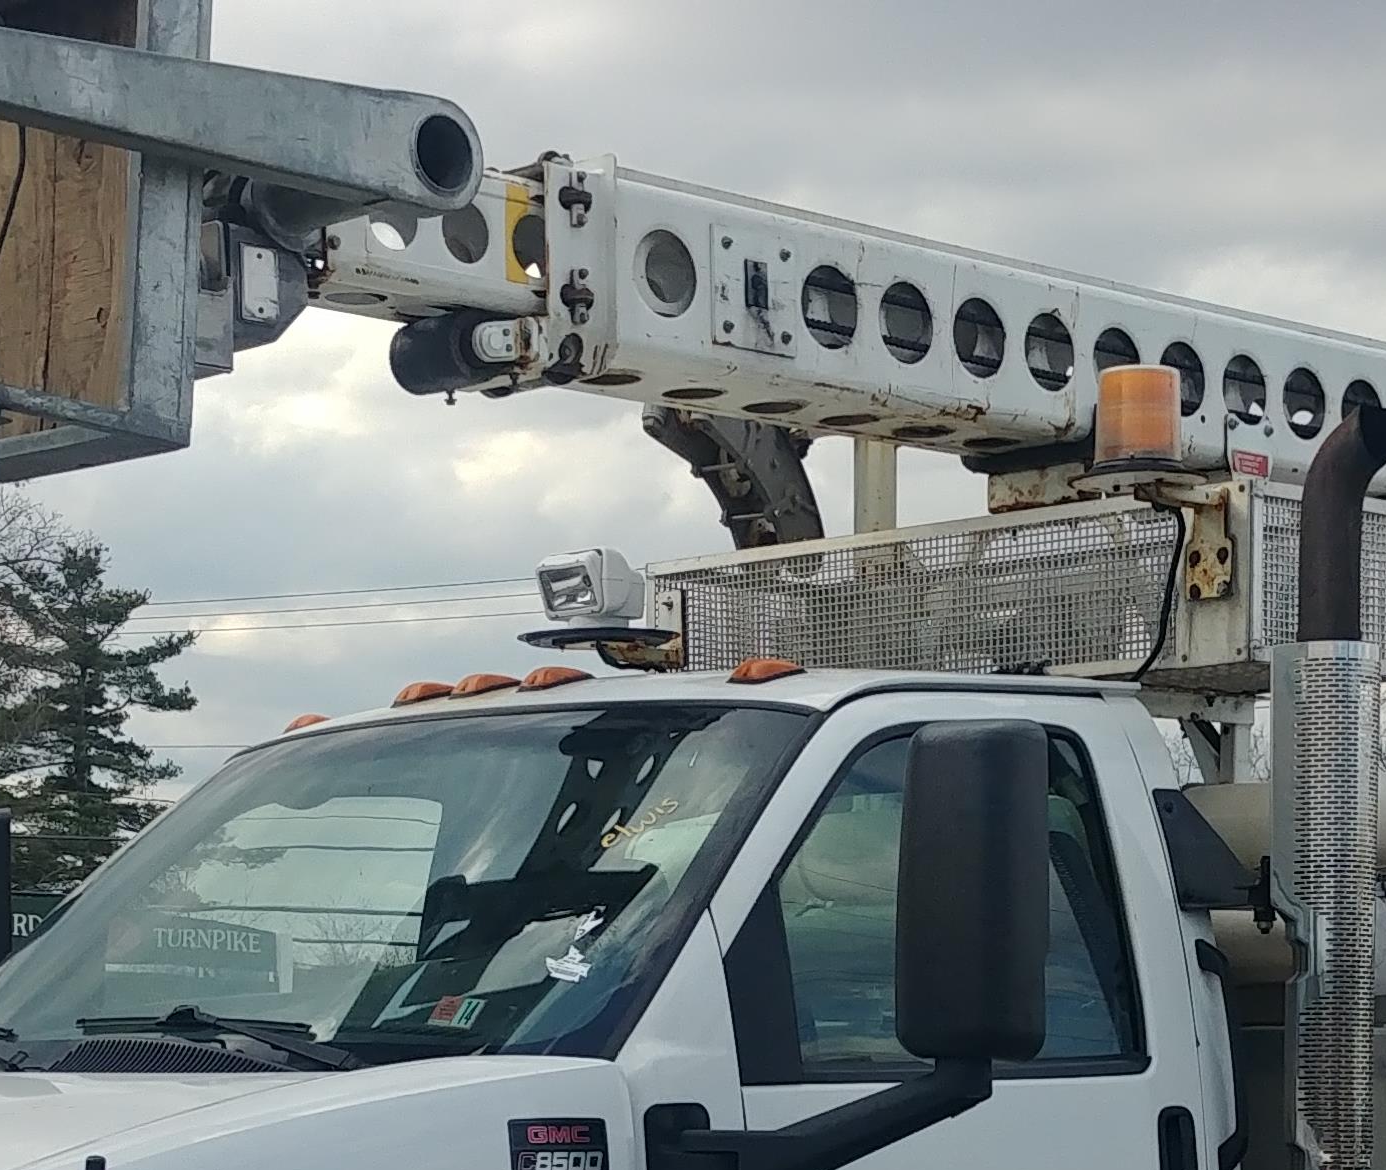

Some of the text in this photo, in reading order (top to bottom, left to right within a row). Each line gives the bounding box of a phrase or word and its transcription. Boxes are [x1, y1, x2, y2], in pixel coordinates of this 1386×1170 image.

[153, 926, 263, 954] TURNPIKE
[457, 1000, 481, 1025] 14
[527, 1125, 591, 1144] GMC
